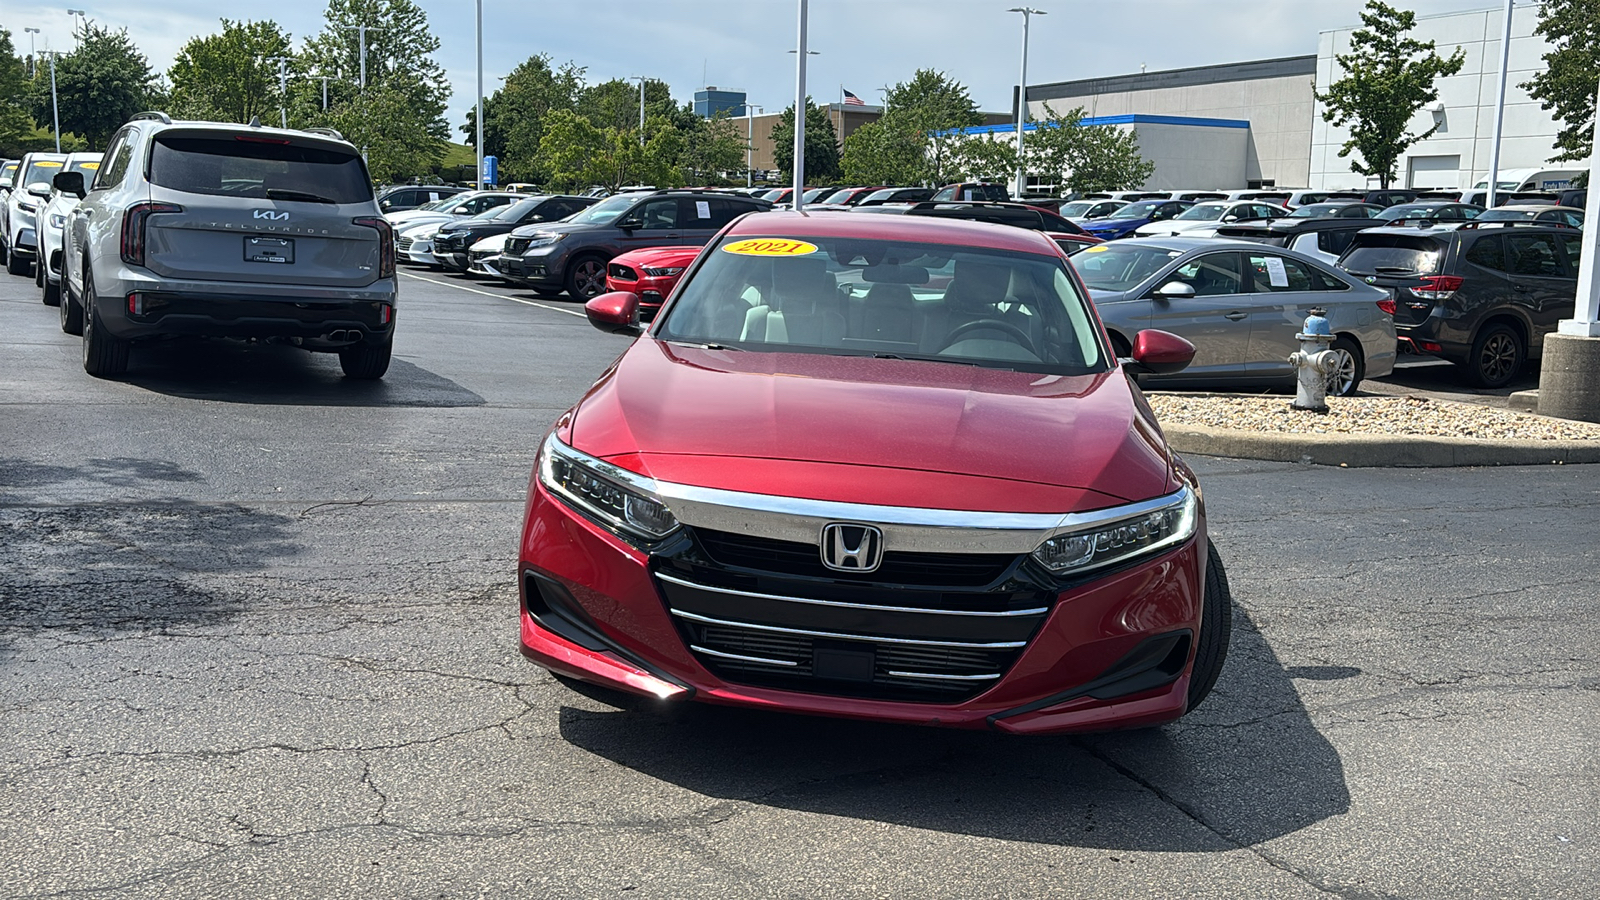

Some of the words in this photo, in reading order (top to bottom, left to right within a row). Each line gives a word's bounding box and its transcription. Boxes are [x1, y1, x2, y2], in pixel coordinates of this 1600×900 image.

[253, 209, 290, 221] KIA
[210, 222, 329, 235] TELLURIDE
[736, 242, 803, 253] 2021
